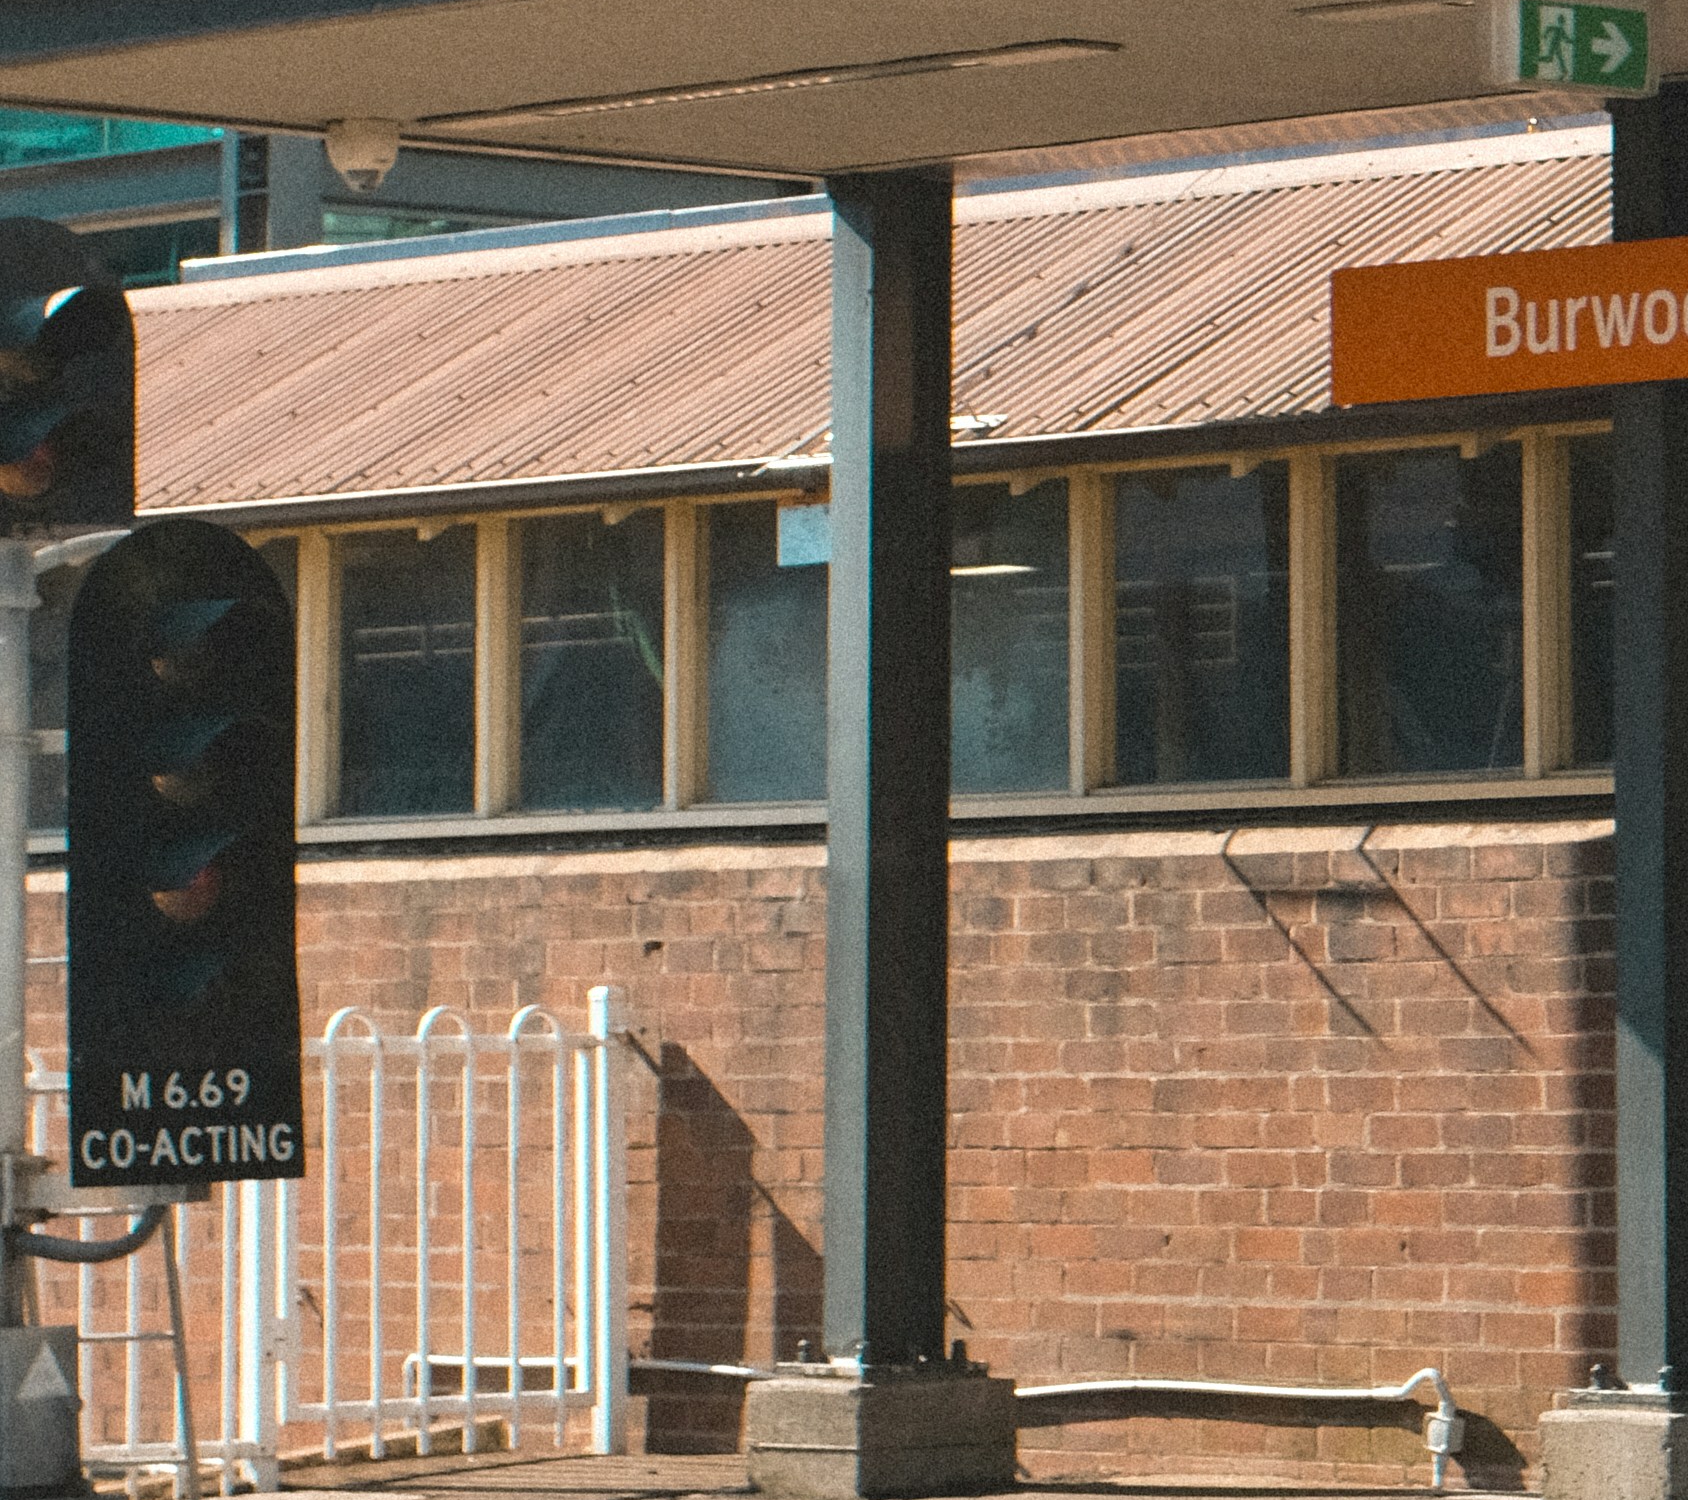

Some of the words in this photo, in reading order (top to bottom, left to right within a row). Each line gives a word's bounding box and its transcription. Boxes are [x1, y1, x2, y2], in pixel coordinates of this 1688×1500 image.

[121, 1071, 150, 1111] M
[163, 1068, 250, 1110] 6.69
[81, 1123, 295, 1170] CO-ACTING
